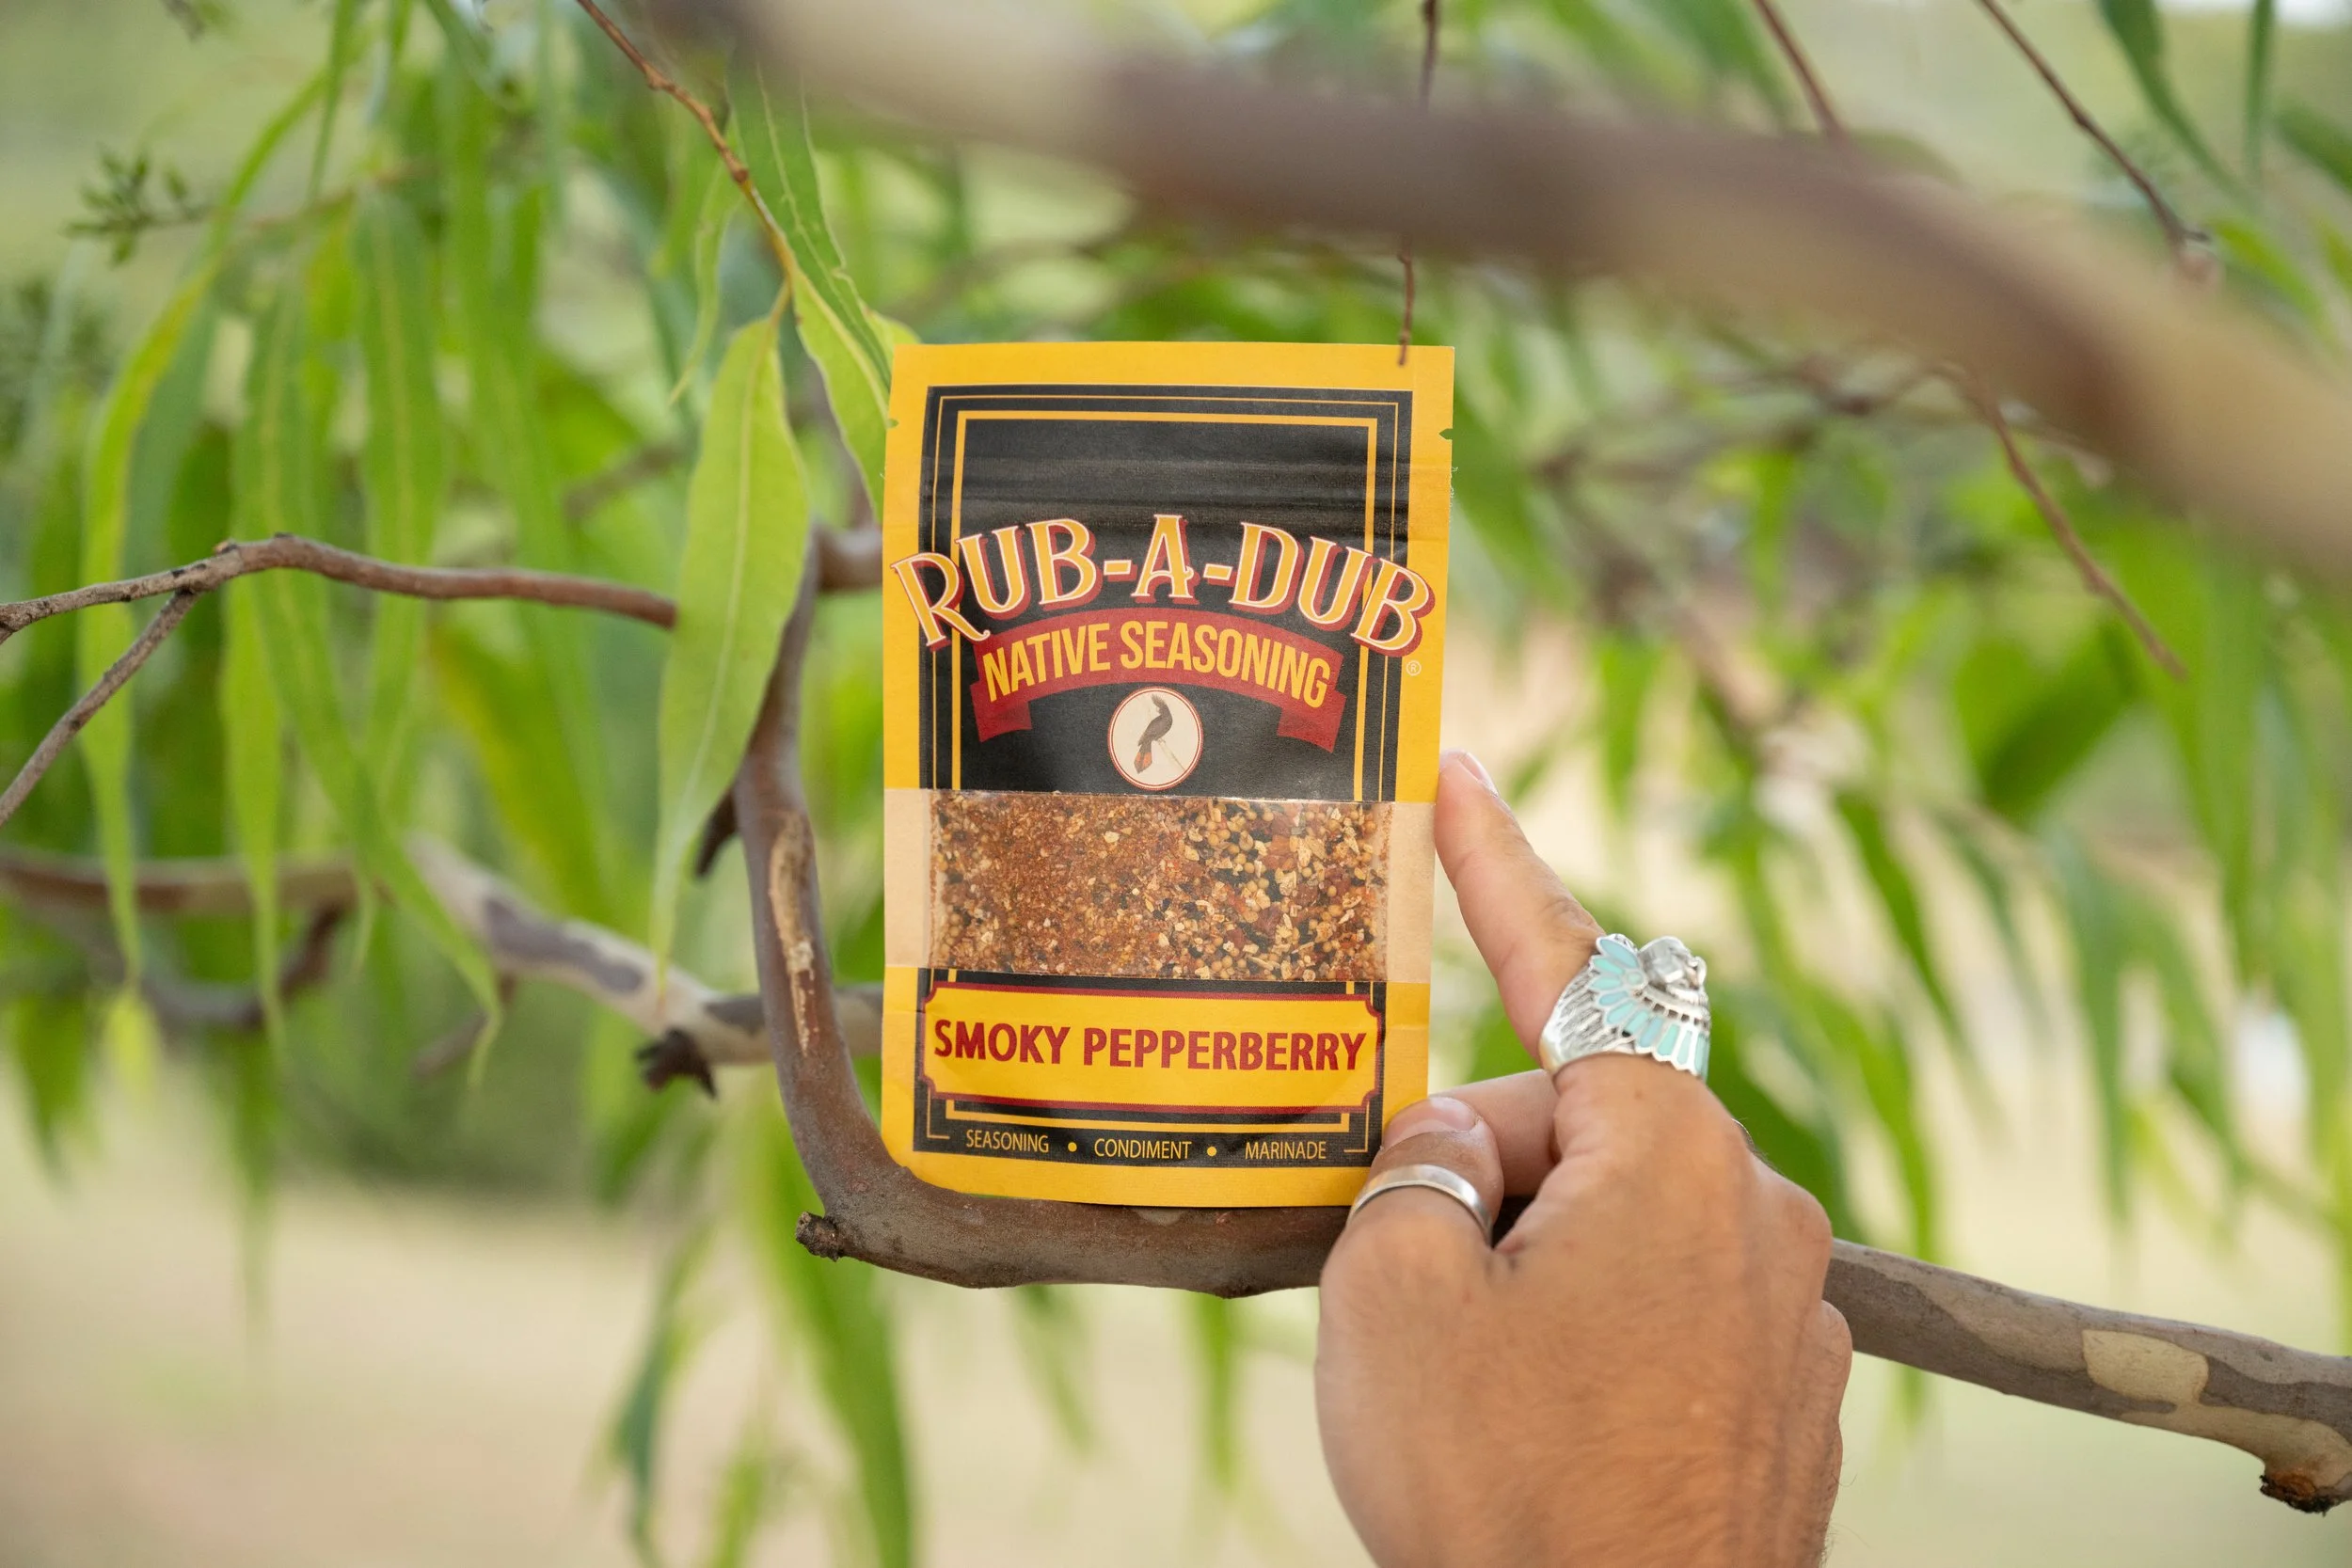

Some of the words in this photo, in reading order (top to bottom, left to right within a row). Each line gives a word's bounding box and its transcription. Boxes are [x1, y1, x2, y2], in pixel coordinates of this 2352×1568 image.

[889, 514, 1436, 657] RUB-A-DUB
[982, 622, 1112, 703] NATIVE
[1120, 619, 1332, 708] SEASONING
[934, 1019, 1071, 1065] SMOKY
[1083, 1027, 1367, 1071] PEPPERBERRY
[965, 1129, 1049, 1154] SEASONING
[1093, 1138, 1192, 1160] CONDIMENT
[1245, 1141, 1327, 1160] MARINADE
